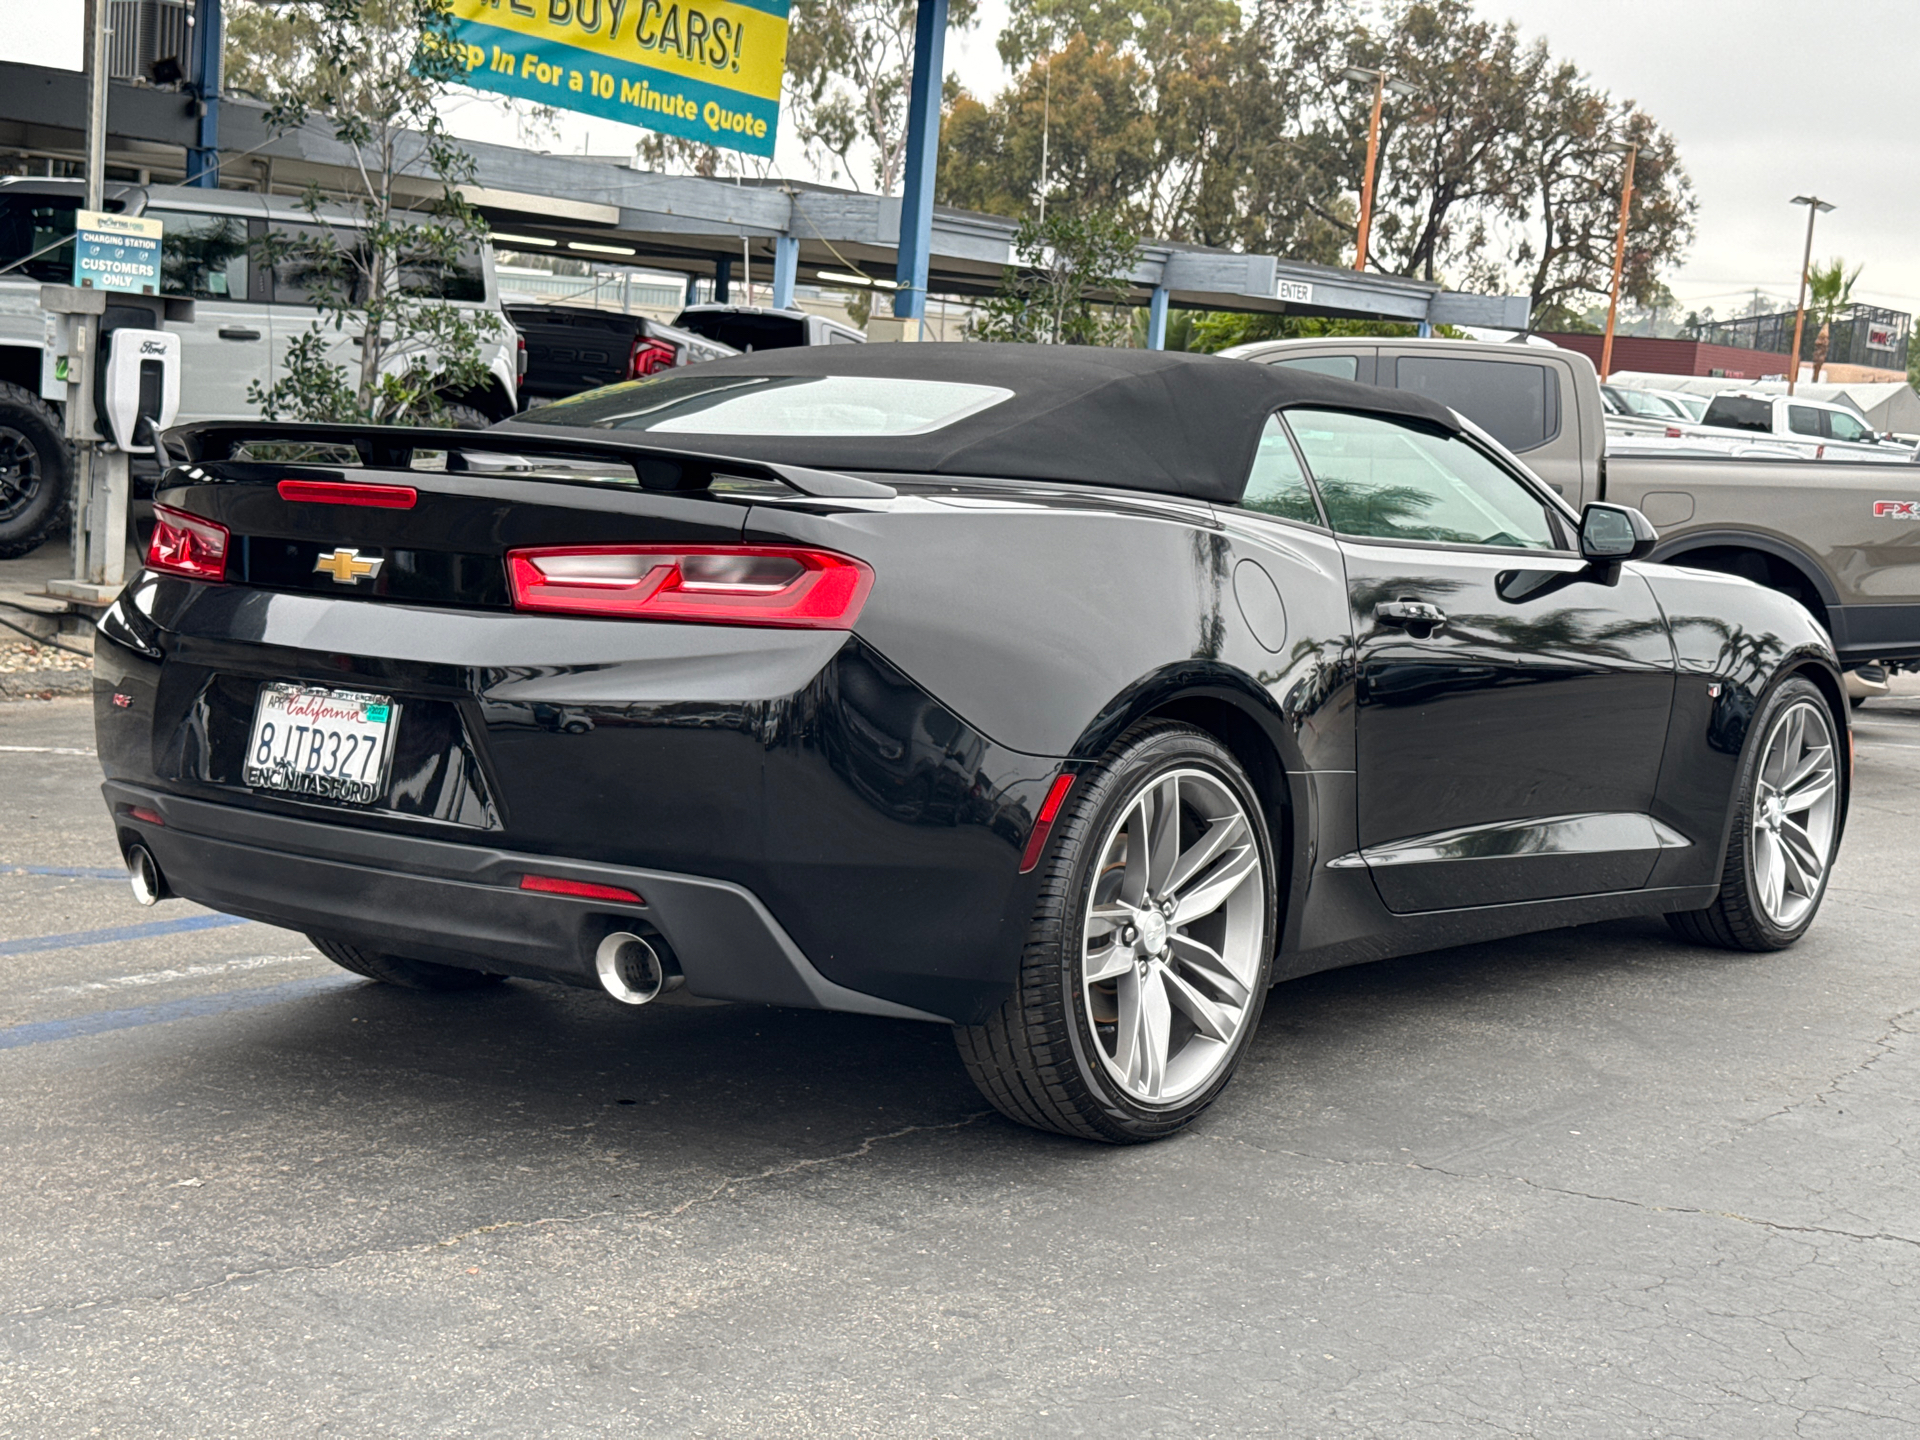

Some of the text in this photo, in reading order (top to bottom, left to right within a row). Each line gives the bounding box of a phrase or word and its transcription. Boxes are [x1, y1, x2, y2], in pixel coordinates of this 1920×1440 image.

[636, 0, 744, 73] CARS!
[490, 45, 515, 75] In
[521, 53, 563, 86] For
[568, 70, 583, 92] a
[590, 69, 615, 99] 10
[620, 78, 698, 121] Minute
[703, 101, 767, 138] Quote
[82, 233, 156, 250] CHARGING STATION
[81, 258, 154, 277] CUSTOMERS
[102, 274, 133, 287] ONLY
[1280, 282, 1308, 300] ENTER
[140, 340, 167, 355] Ford
[286, 694, 368, 725] California
[256, 722, 377, 780] 8JTB327
